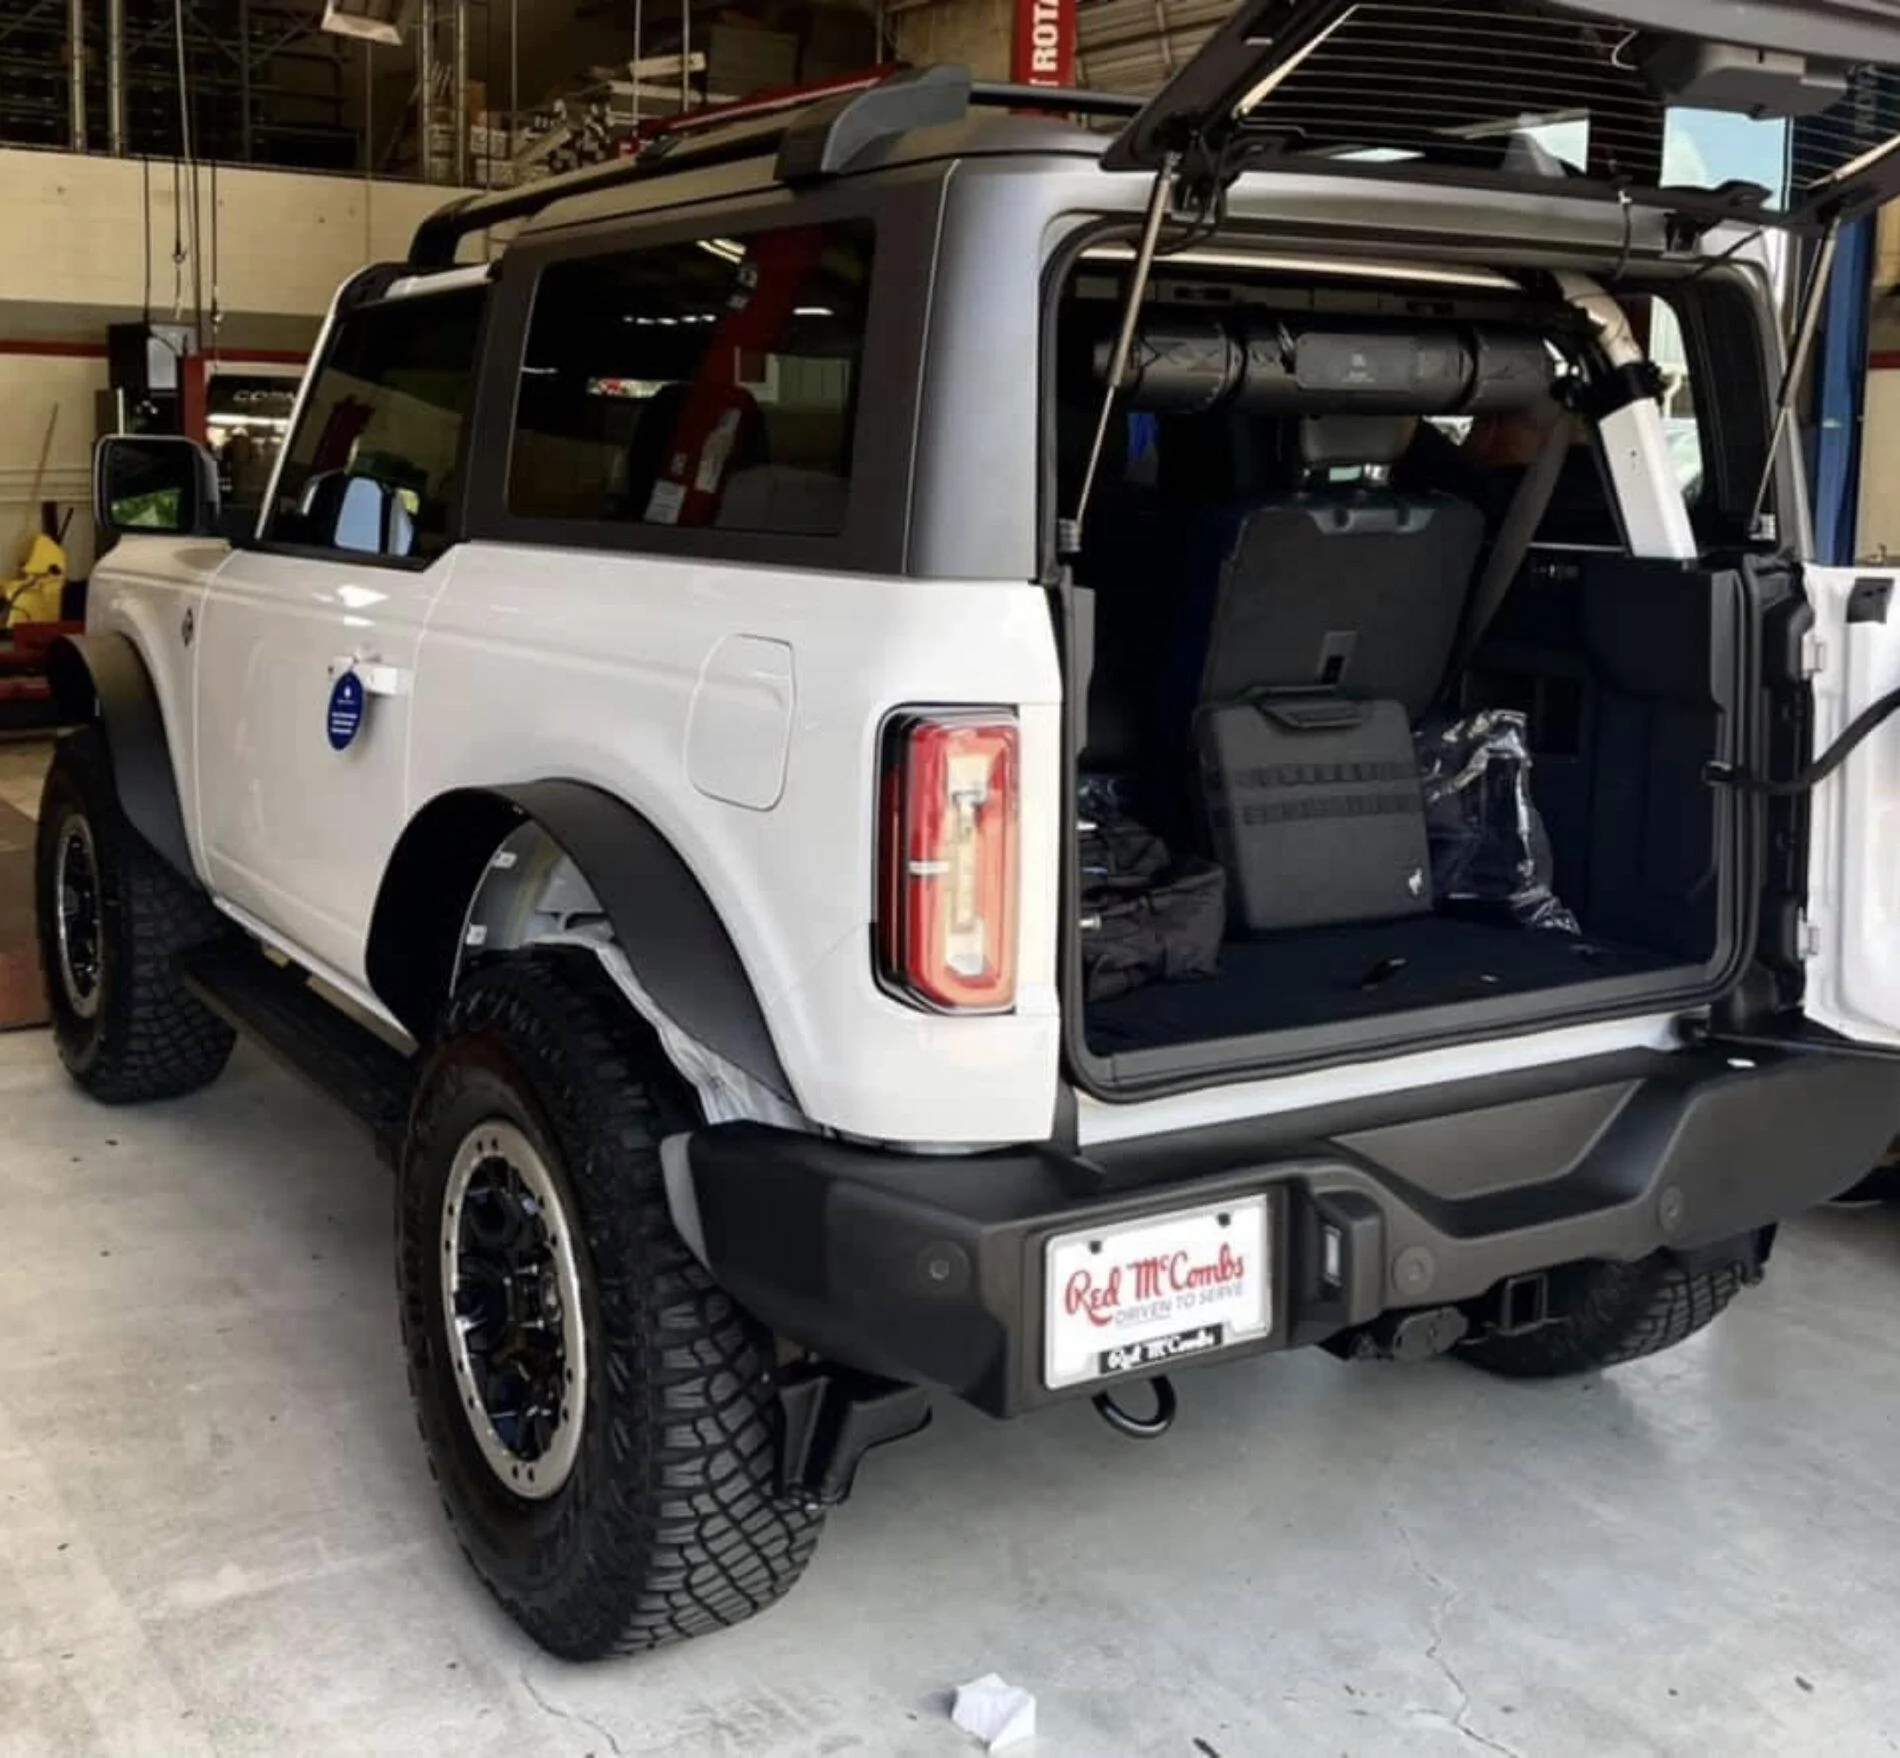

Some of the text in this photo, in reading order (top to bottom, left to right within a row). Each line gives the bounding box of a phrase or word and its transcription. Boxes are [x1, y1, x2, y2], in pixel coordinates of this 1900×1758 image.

[1065, 1241, 1244, 1326] Red McCombs
[1115, 1283, 1243, 1325] DRIVEN TO SERVE
